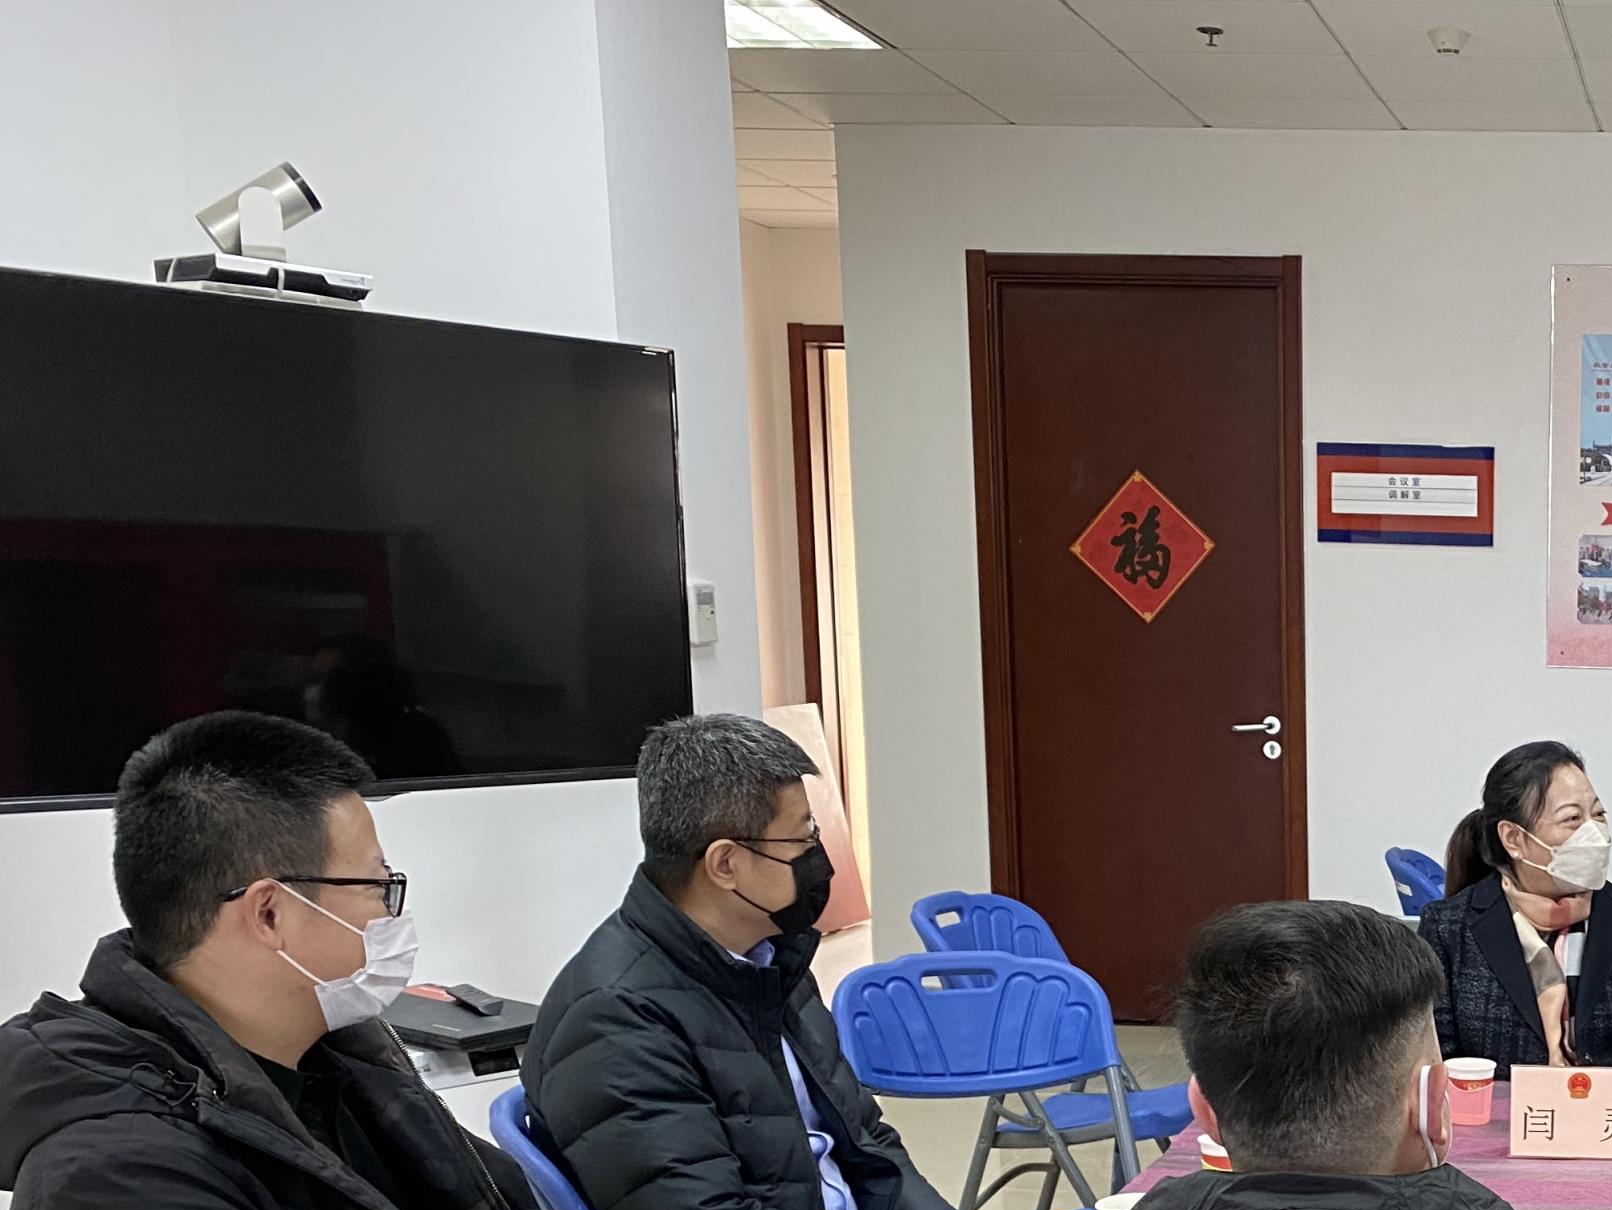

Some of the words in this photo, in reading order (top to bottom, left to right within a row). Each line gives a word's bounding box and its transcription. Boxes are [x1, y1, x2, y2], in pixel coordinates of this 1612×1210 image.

[1388, 477, 1422, 487] 会议室
[1388, 490, 1422, 500] 调解室
[1111, 504, 1171, 590] 福
